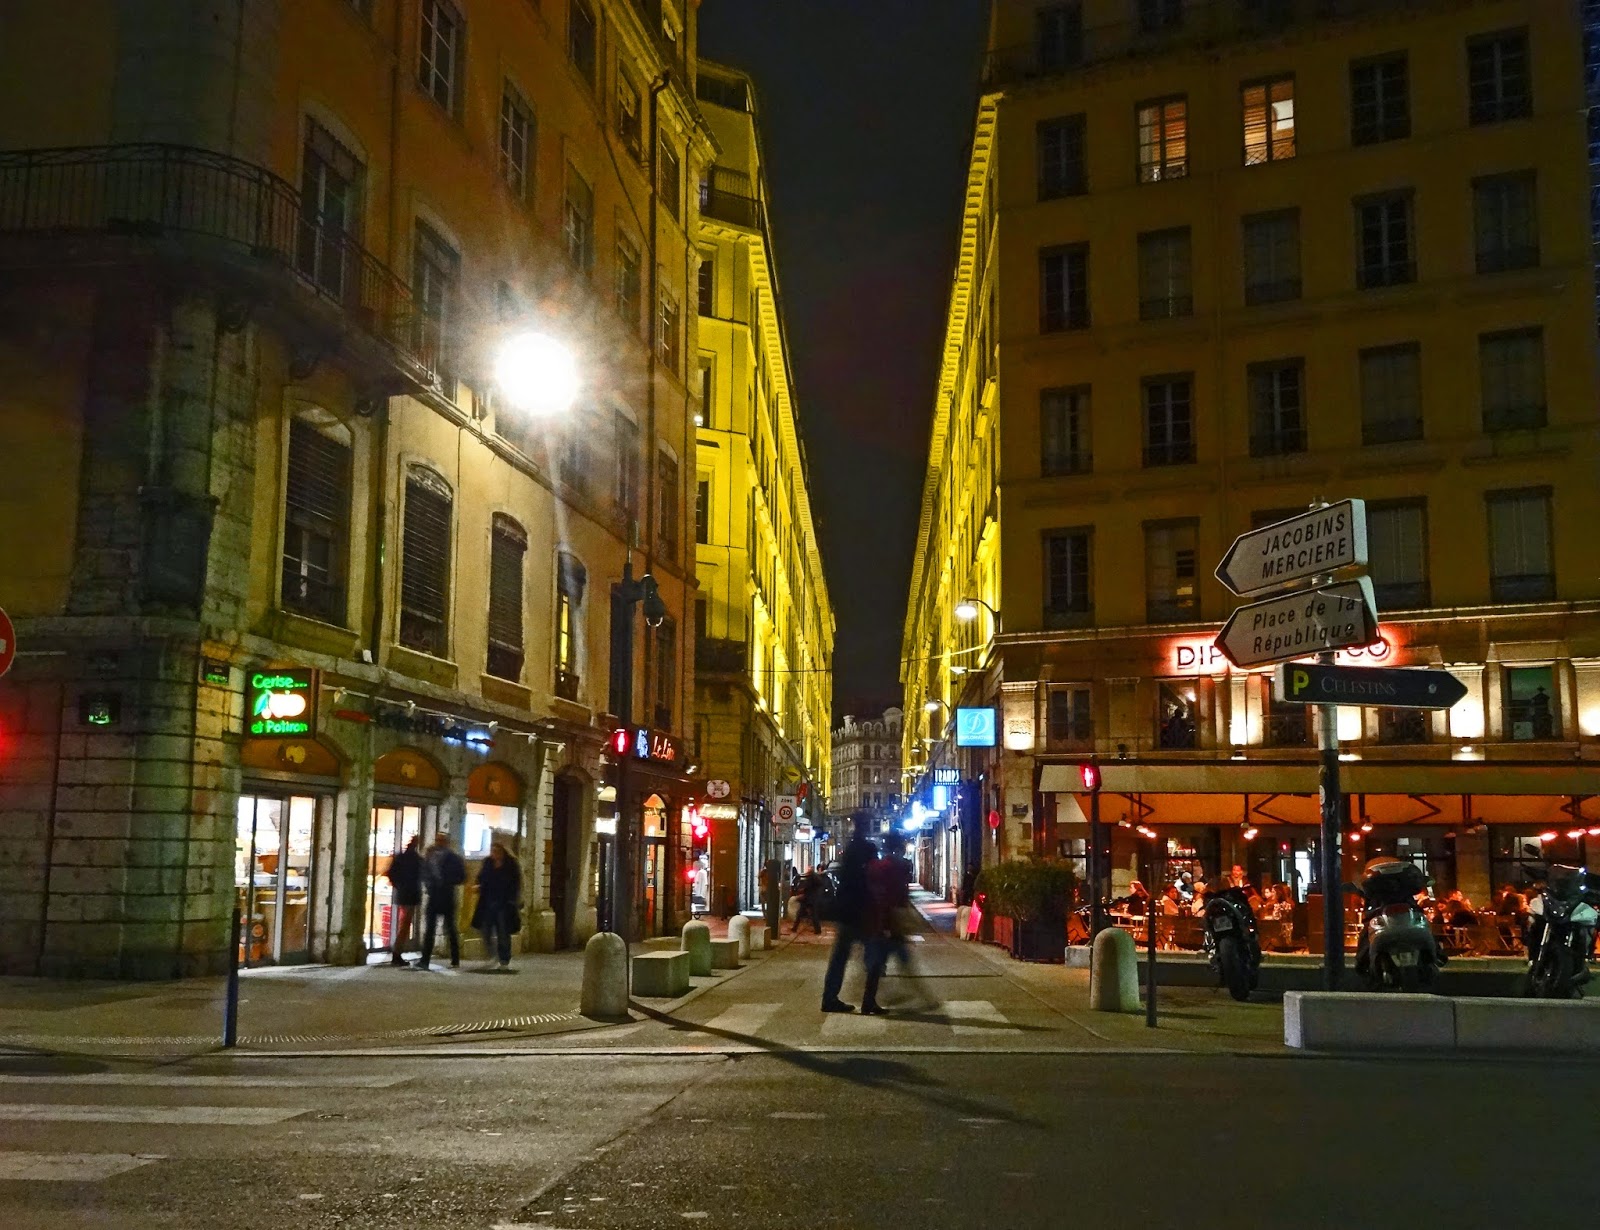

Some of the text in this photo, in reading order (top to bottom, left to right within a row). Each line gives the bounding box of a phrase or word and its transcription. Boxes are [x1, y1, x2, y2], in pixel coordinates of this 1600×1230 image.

[1261, 513, 1345, 556] JACOBINS
[1261, 537, 1347, 579] MERCIERE
[1253, 597, 1356, 631] Place de la
[1253, 622, 1355, 655] République
[1293, 670, 1310, 696] P
[251, 720, 308, 734] et Potiron
[934, 769, 960, 783] TRAMPS
